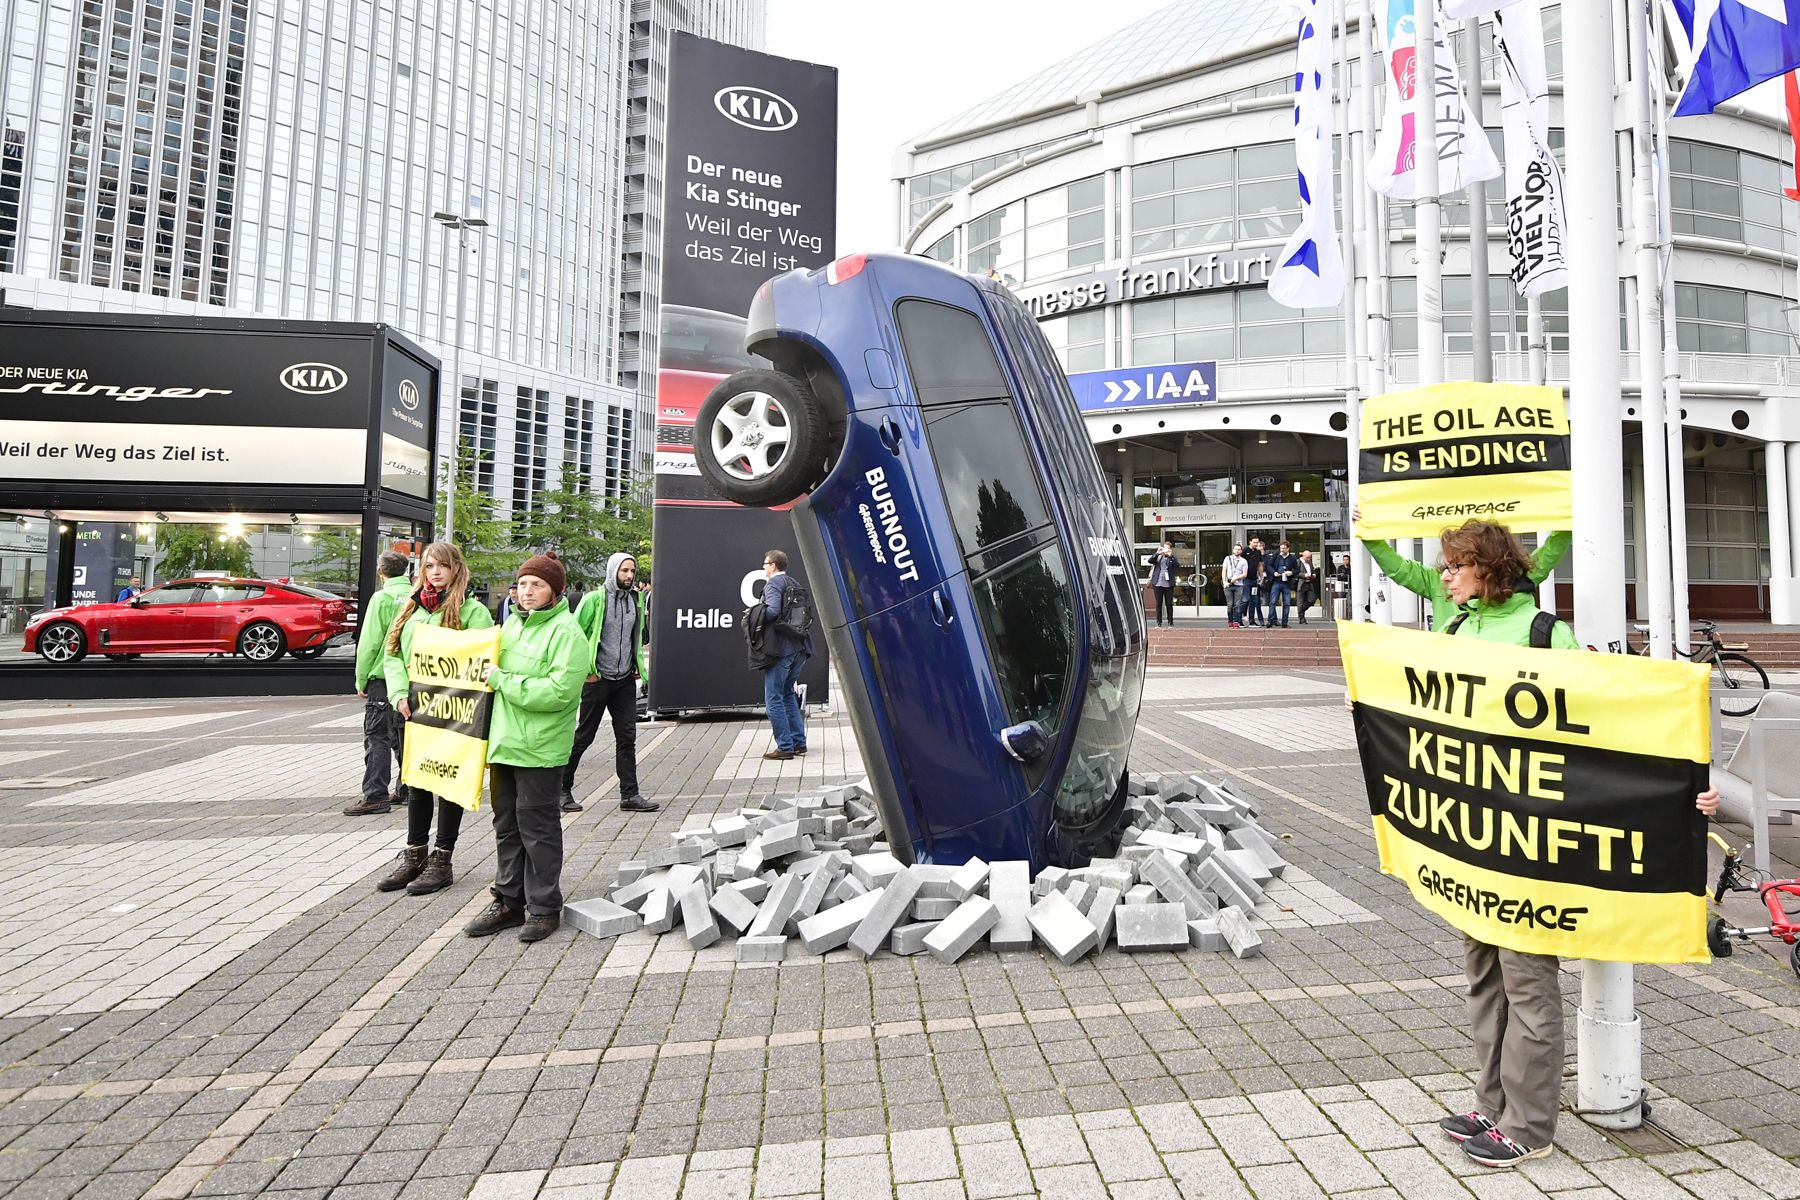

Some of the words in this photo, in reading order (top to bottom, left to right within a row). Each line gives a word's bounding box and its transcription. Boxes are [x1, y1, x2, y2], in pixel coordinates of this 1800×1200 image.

[729, 91, 785, 125] KIA
[687, 154, 726, 178] Der
[732, 167, 782, 188] neue
[686, 181, 719, 204] Kia
[726, 189, 801, 217] Stinger
[685, 212, 730, 236] Weil
[738, 222, 772, 242] der
[778, 226, 822, 254] Weg
[1525, 213, 1544, 272] VIEL
[685, 240, 723, 261] das
[730, 246, 766, 268] Ziel
[1022, 280, 1107, 319] messe
[1115, 251, 1271, 299] frankfurt
[27, 367, 63, 379] NEUE
[67, 369, 88, 380] KIA
[292, 369, 337, 389] KIA
[1146, 369, 1209, 399] IAA
[402, 384, 416, 405] KIA
[1373, 413, 1424, 440] THE
[1433, 408, 1484, 432] OIL
[1494, 406, 1554, 429] AGE
[36, 443, 68, 458] der
[75, 444, 116, 462] Weg
[123, 445, 156, 460] das
[162, 446, 195, 461] Ziel
[201, 447, 229, 461] ist.
[1383, 452, 1411, 473] IS
[1419, 440, 1548, 471] ENDING!
[865, 466, 919, 581] BURNOUT
[1187, 513, 1217, 521] frankfurt
[1241, 512, 1273, 520] Eingang
[1275, 511, 1291, 520] City
[1297, 511, 1332, 519] Entrance
[1412, 501, 1521, 520] GREENPEACE
[858, 503, 887, 564] GREENPEACE
[676, 608, 733, 629] Halle
[414, 653, 438, 677] THE
[438, 656, 461, 680] OIL
[418, 691, 432, 716] IS
[428, 692, 480, 725] ENDING!
[1404, 666, 1486, 718] MIT
[1504, 670, 1590, 735] ÖL
[1408, 727, 1565, 801] KEINE
[1383, 774, 1644, 875] ZUKUNFT!
[1418, 864, 1589, 932] GREENPEACE
